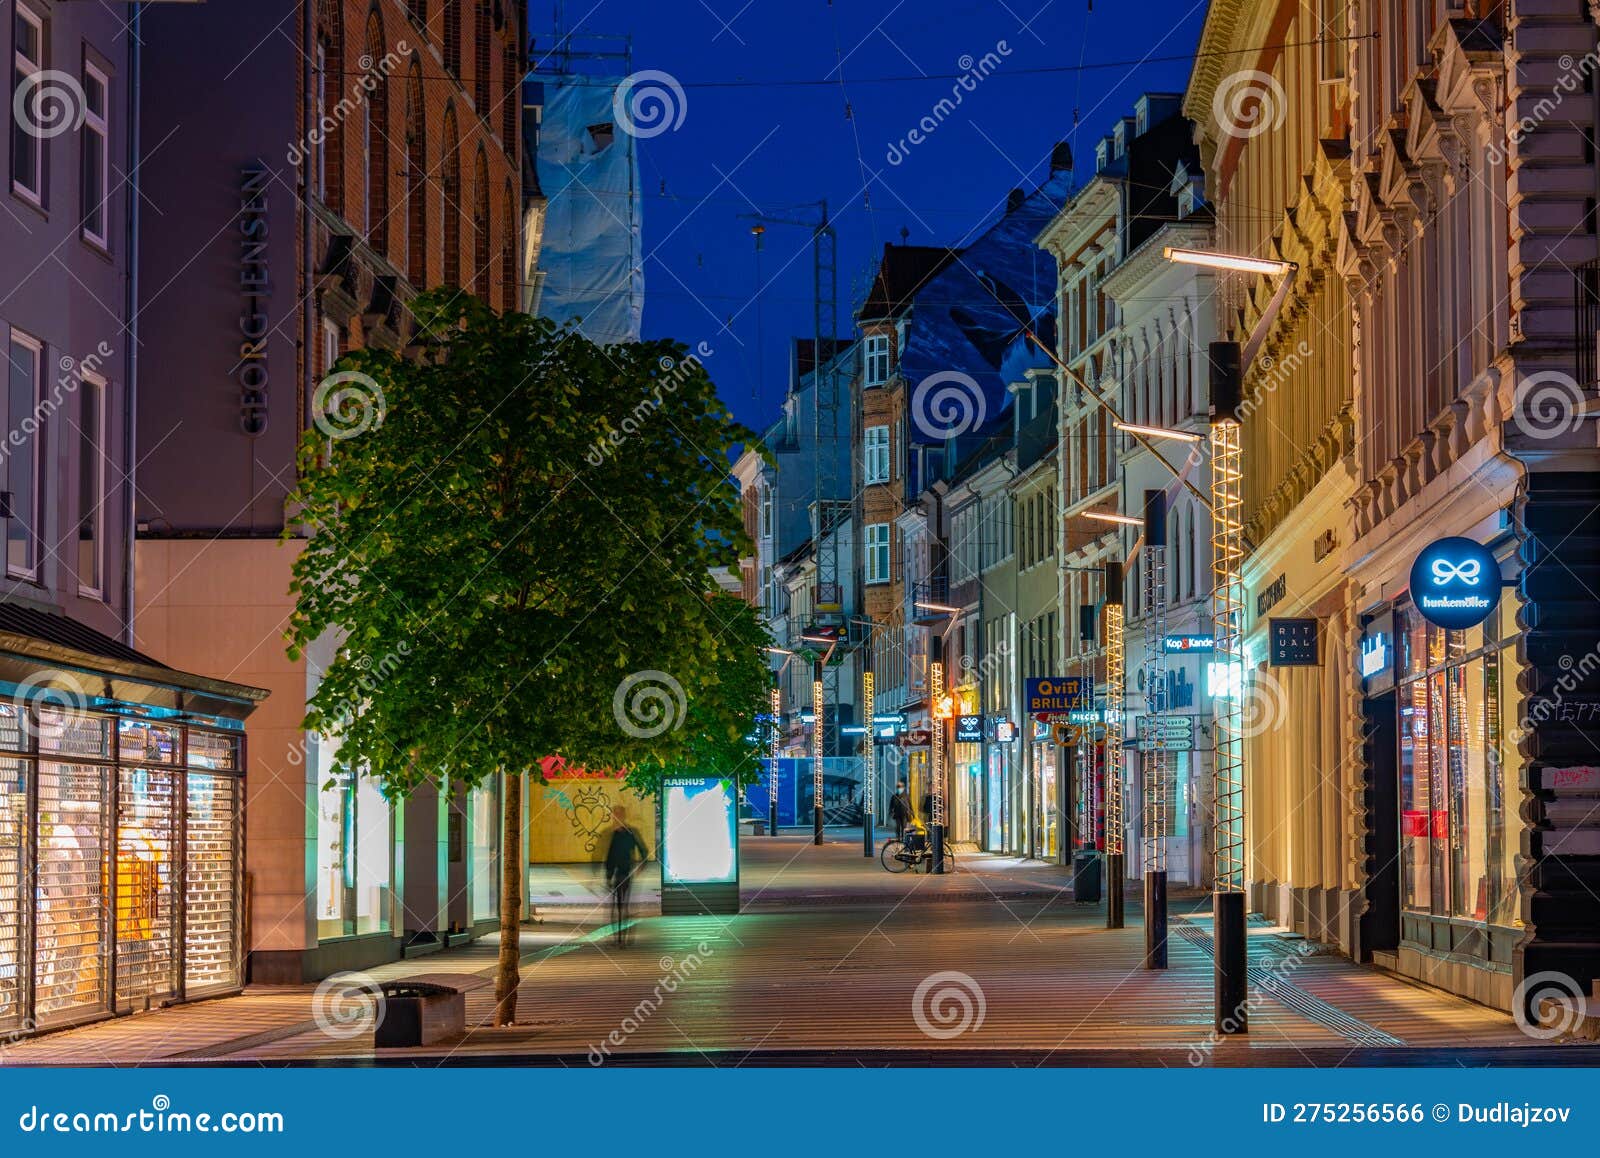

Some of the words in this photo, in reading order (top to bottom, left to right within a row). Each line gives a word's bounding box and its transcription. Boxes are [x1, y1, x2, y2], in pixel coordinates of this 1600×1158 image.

[239, 168, 270, 296] JENSEN
[239, 314, 269, 437] GEORG
[1423, 595, 1490, 608] hunkemöller
[1037, 680, 1079, 695] Qvist
[663, 777, 706, 787] AARHUS
